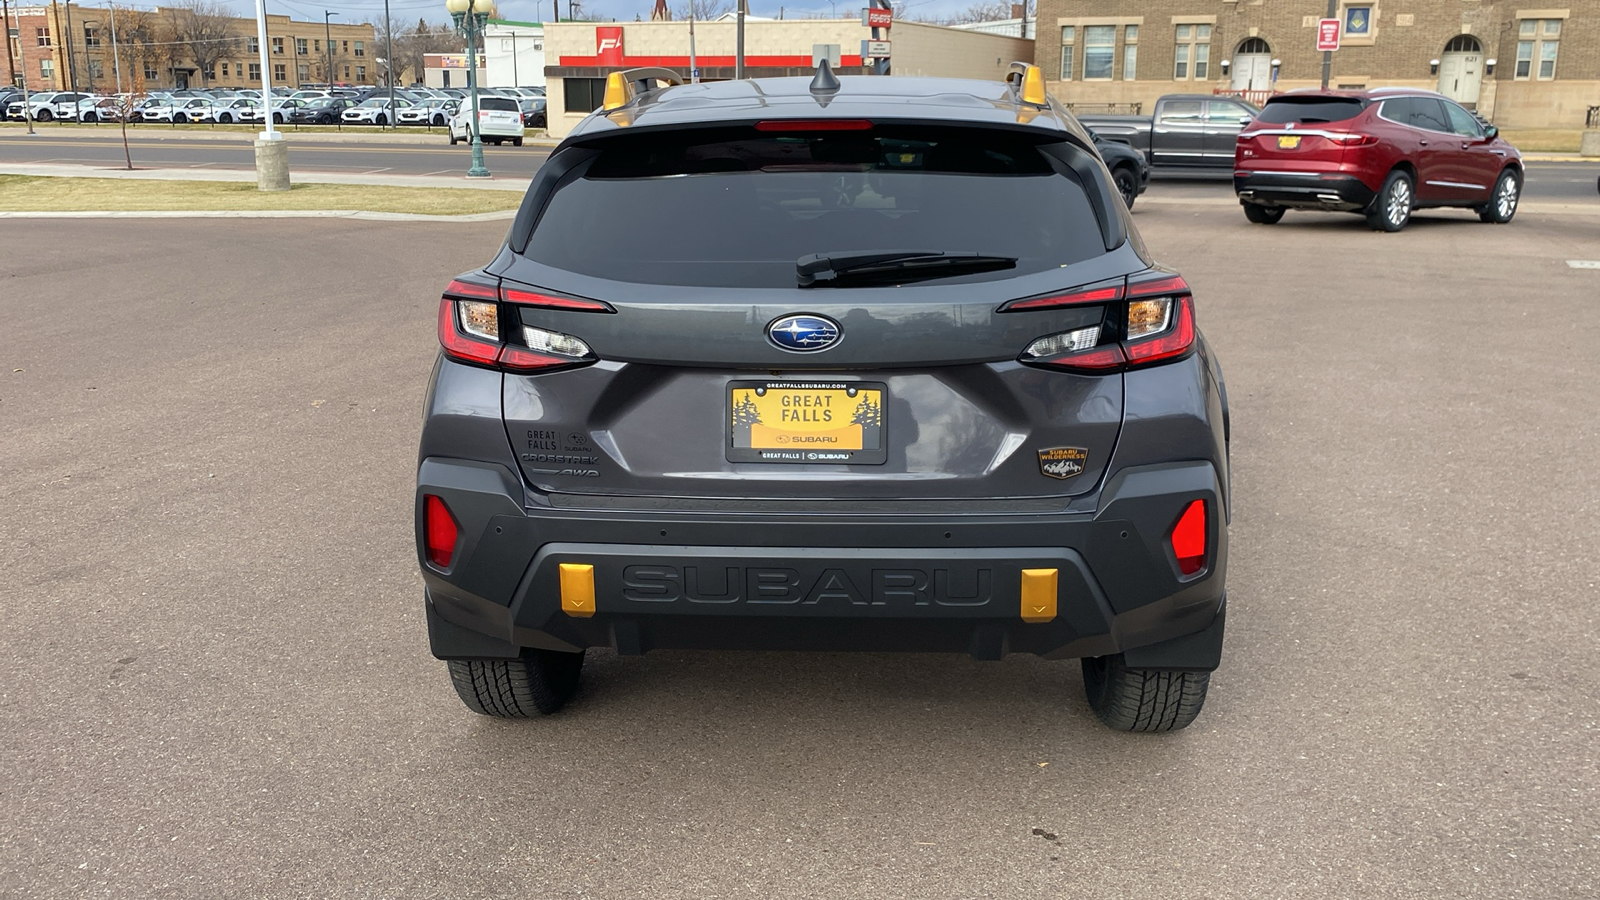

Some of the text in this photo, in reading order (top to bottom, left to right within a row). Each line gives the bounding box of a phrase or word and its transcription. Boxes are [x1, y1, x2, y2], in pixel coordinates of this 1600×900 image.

[782, 395, 832, 407] GREAT
[782, 409, 832, 422] FALLS
[527, 430, 555, 439] GREAT
[528, 440, 557, 450] FALLS
[521, 453, 600, 465] CROSSTREK
[557, 469, 601, 477] AWD
[622, 564, 992, 607] SUBARU
